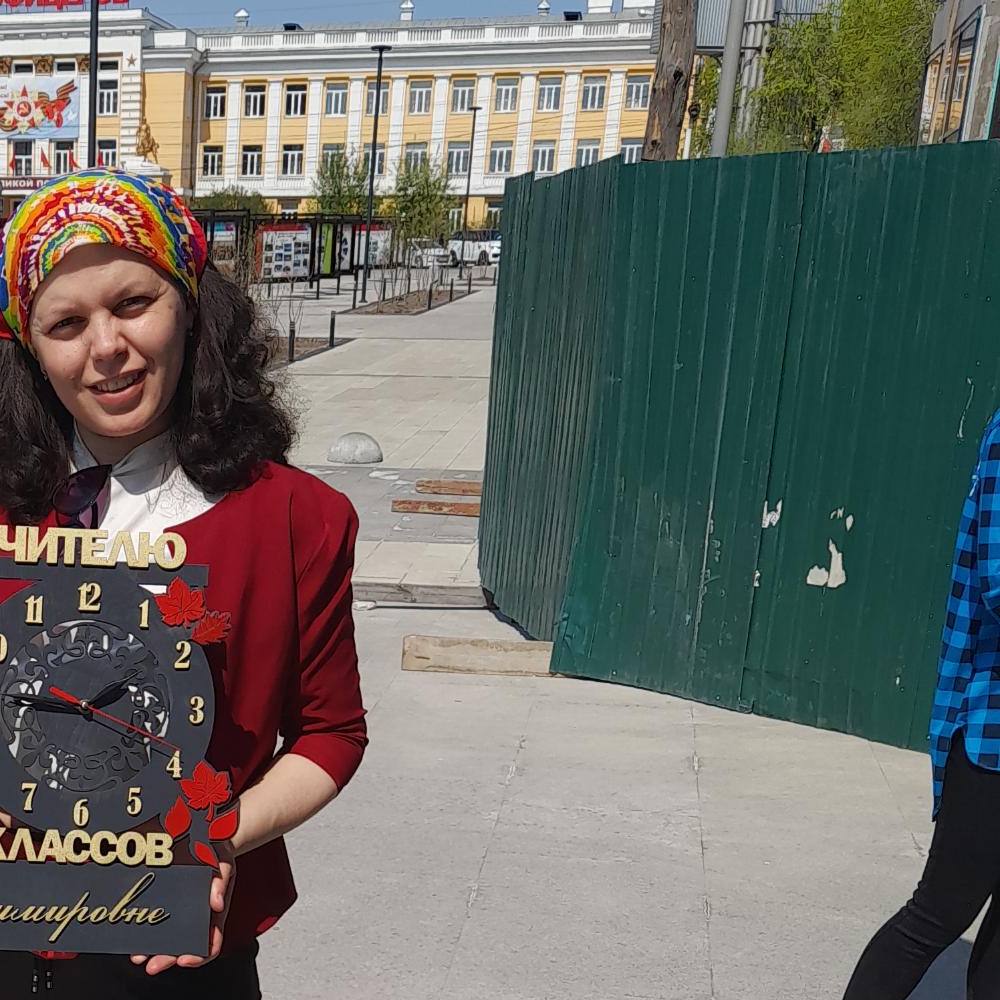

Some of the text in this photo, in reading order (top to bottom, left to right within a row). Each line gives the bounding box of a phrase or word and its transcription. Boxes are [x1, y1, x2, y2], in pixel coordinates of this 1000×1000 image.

[25, 595, 44, 624] 11
[78, 582, 102, 611] 12
[138, 599, 149, 628] 1
[174, 640, 192, 669] 2
[188, 695, 204, 724] 3
[166, 750, 182, 778] 4
[21, 782, 37, 811] 7
[127, 786, 142, 815] 5
[73, 798, 89, 827] 6
